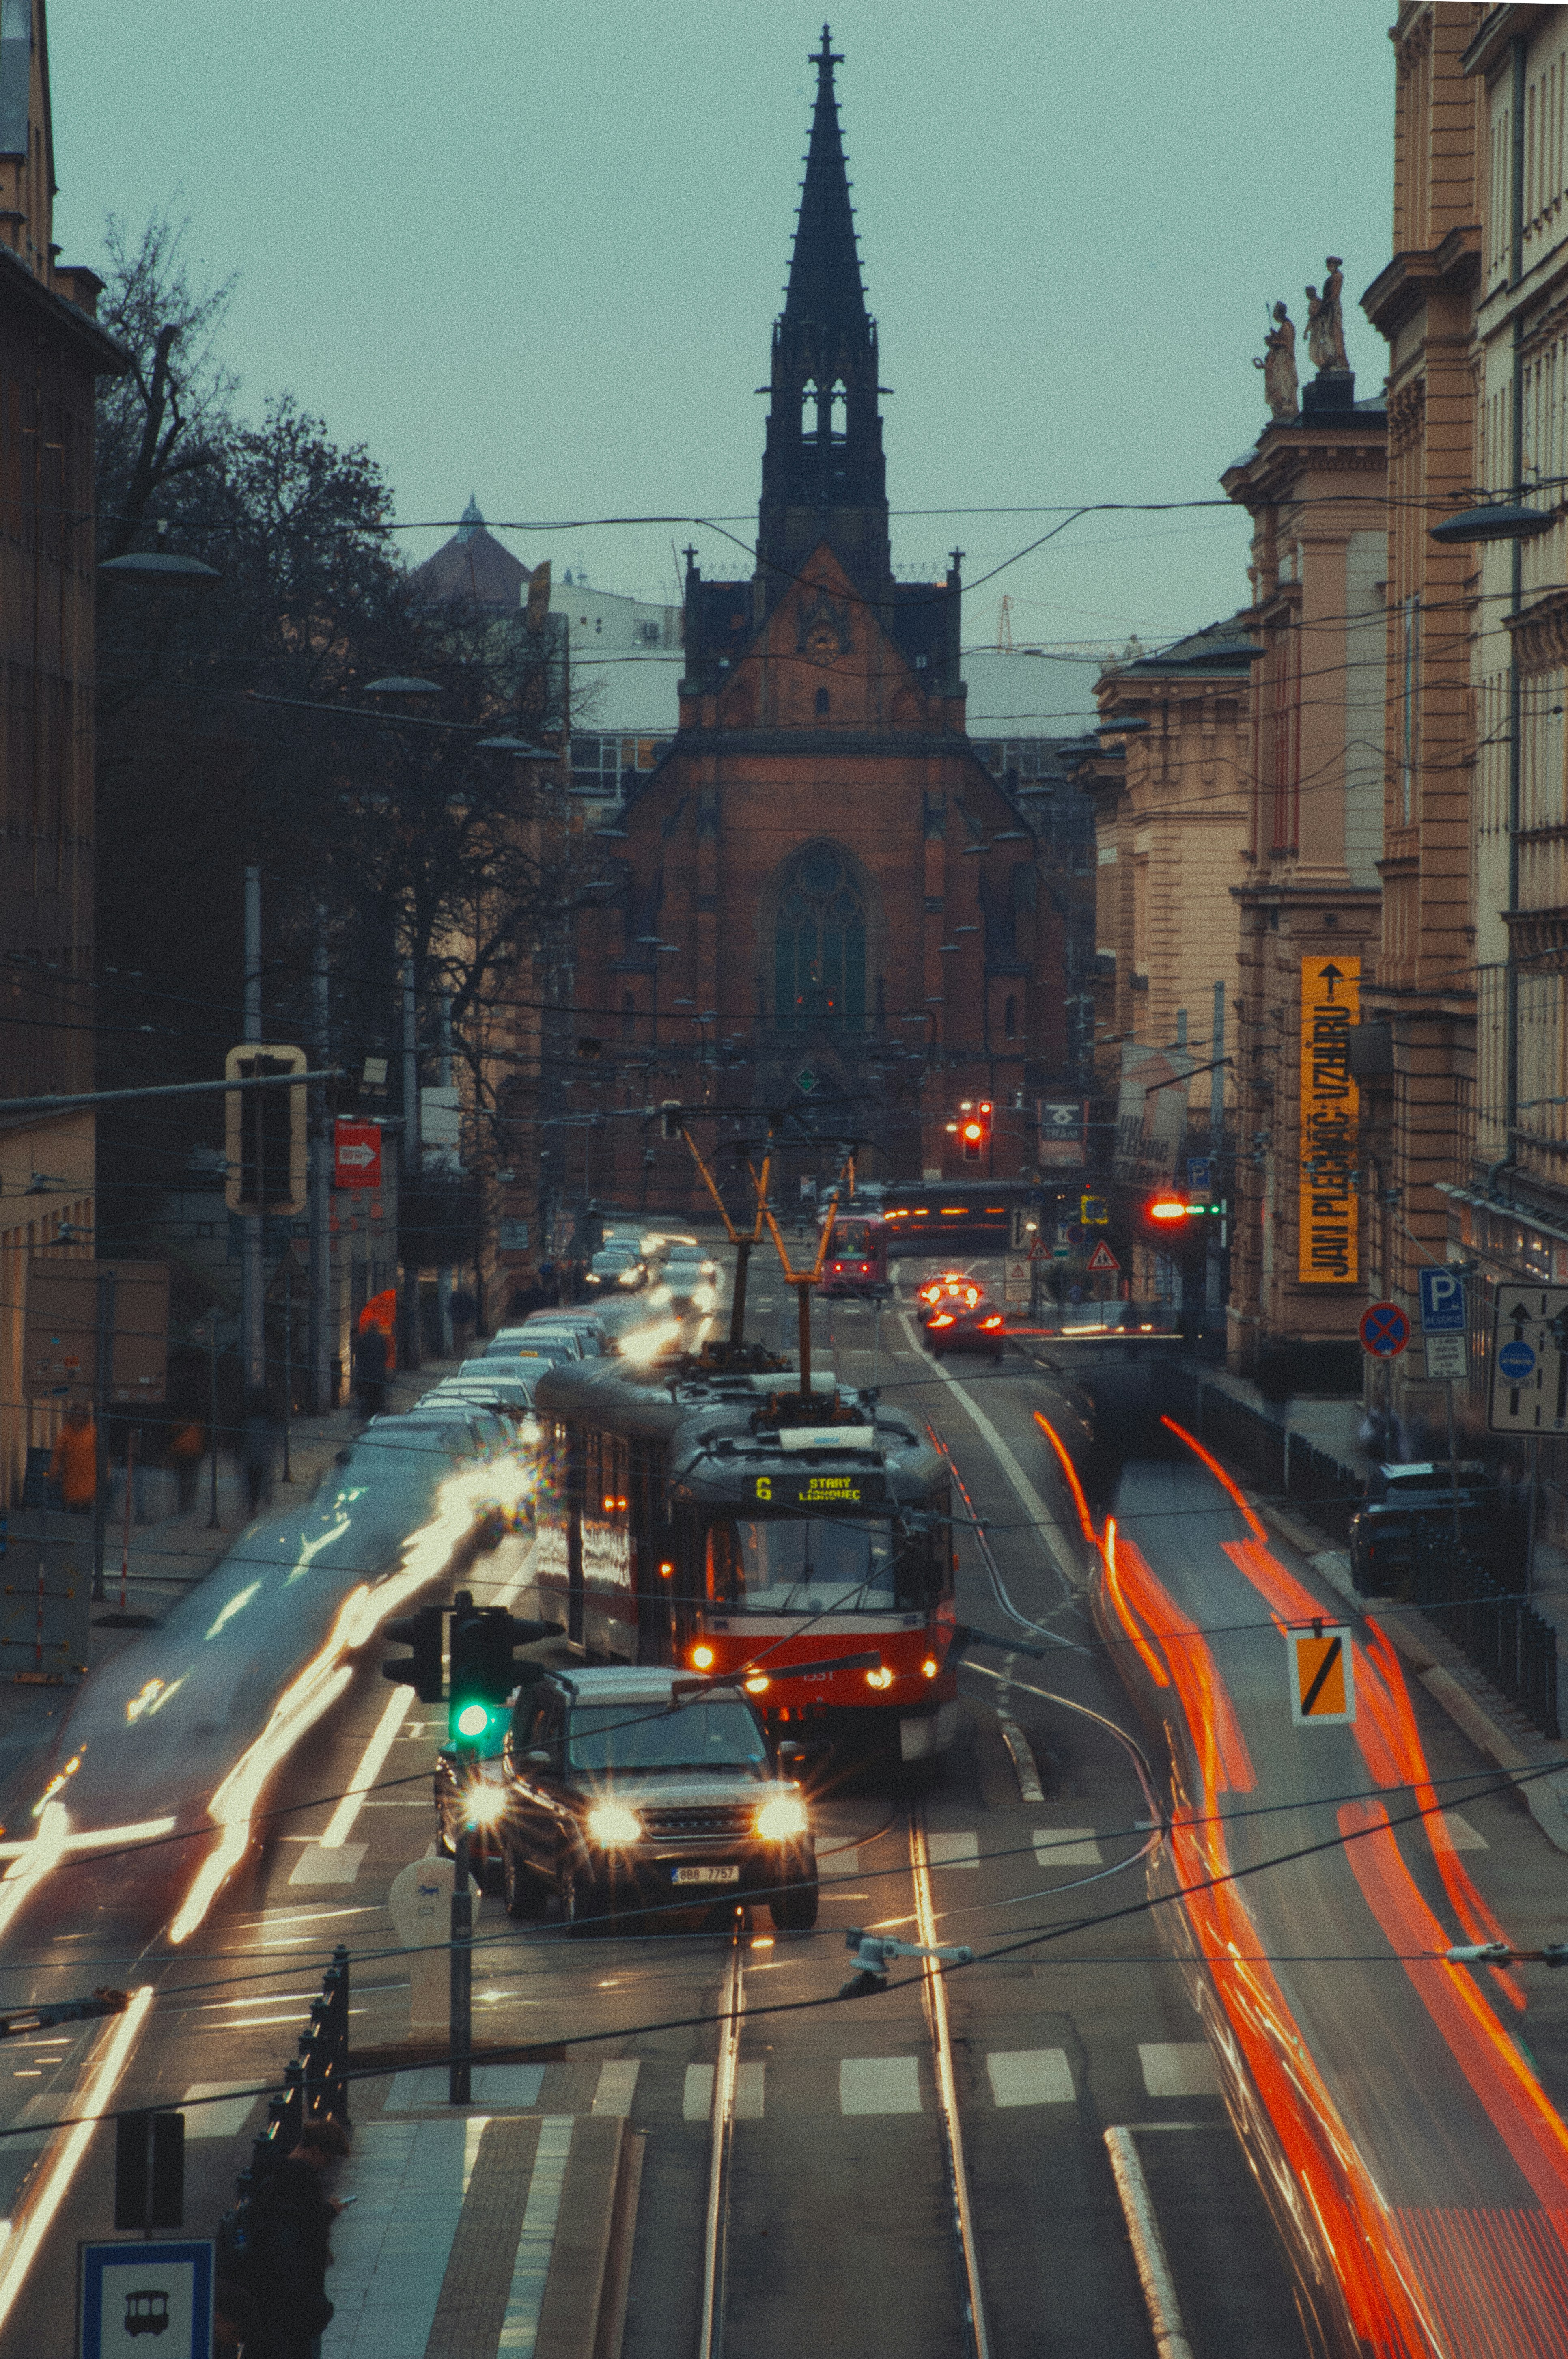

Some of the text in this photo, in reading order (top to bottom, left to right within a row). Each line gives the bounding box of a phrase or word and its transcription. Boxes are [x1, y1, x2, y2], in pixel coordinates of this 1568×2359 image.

[1045, 1127, 1079, 1139] TRAM
[1192, 1165, 1205, 1184] P
[1311, 1225, 1348, 1277] JAN
[1431, 1275, 1456, 1312] P
[756, 1477, 772, 1501] 6
